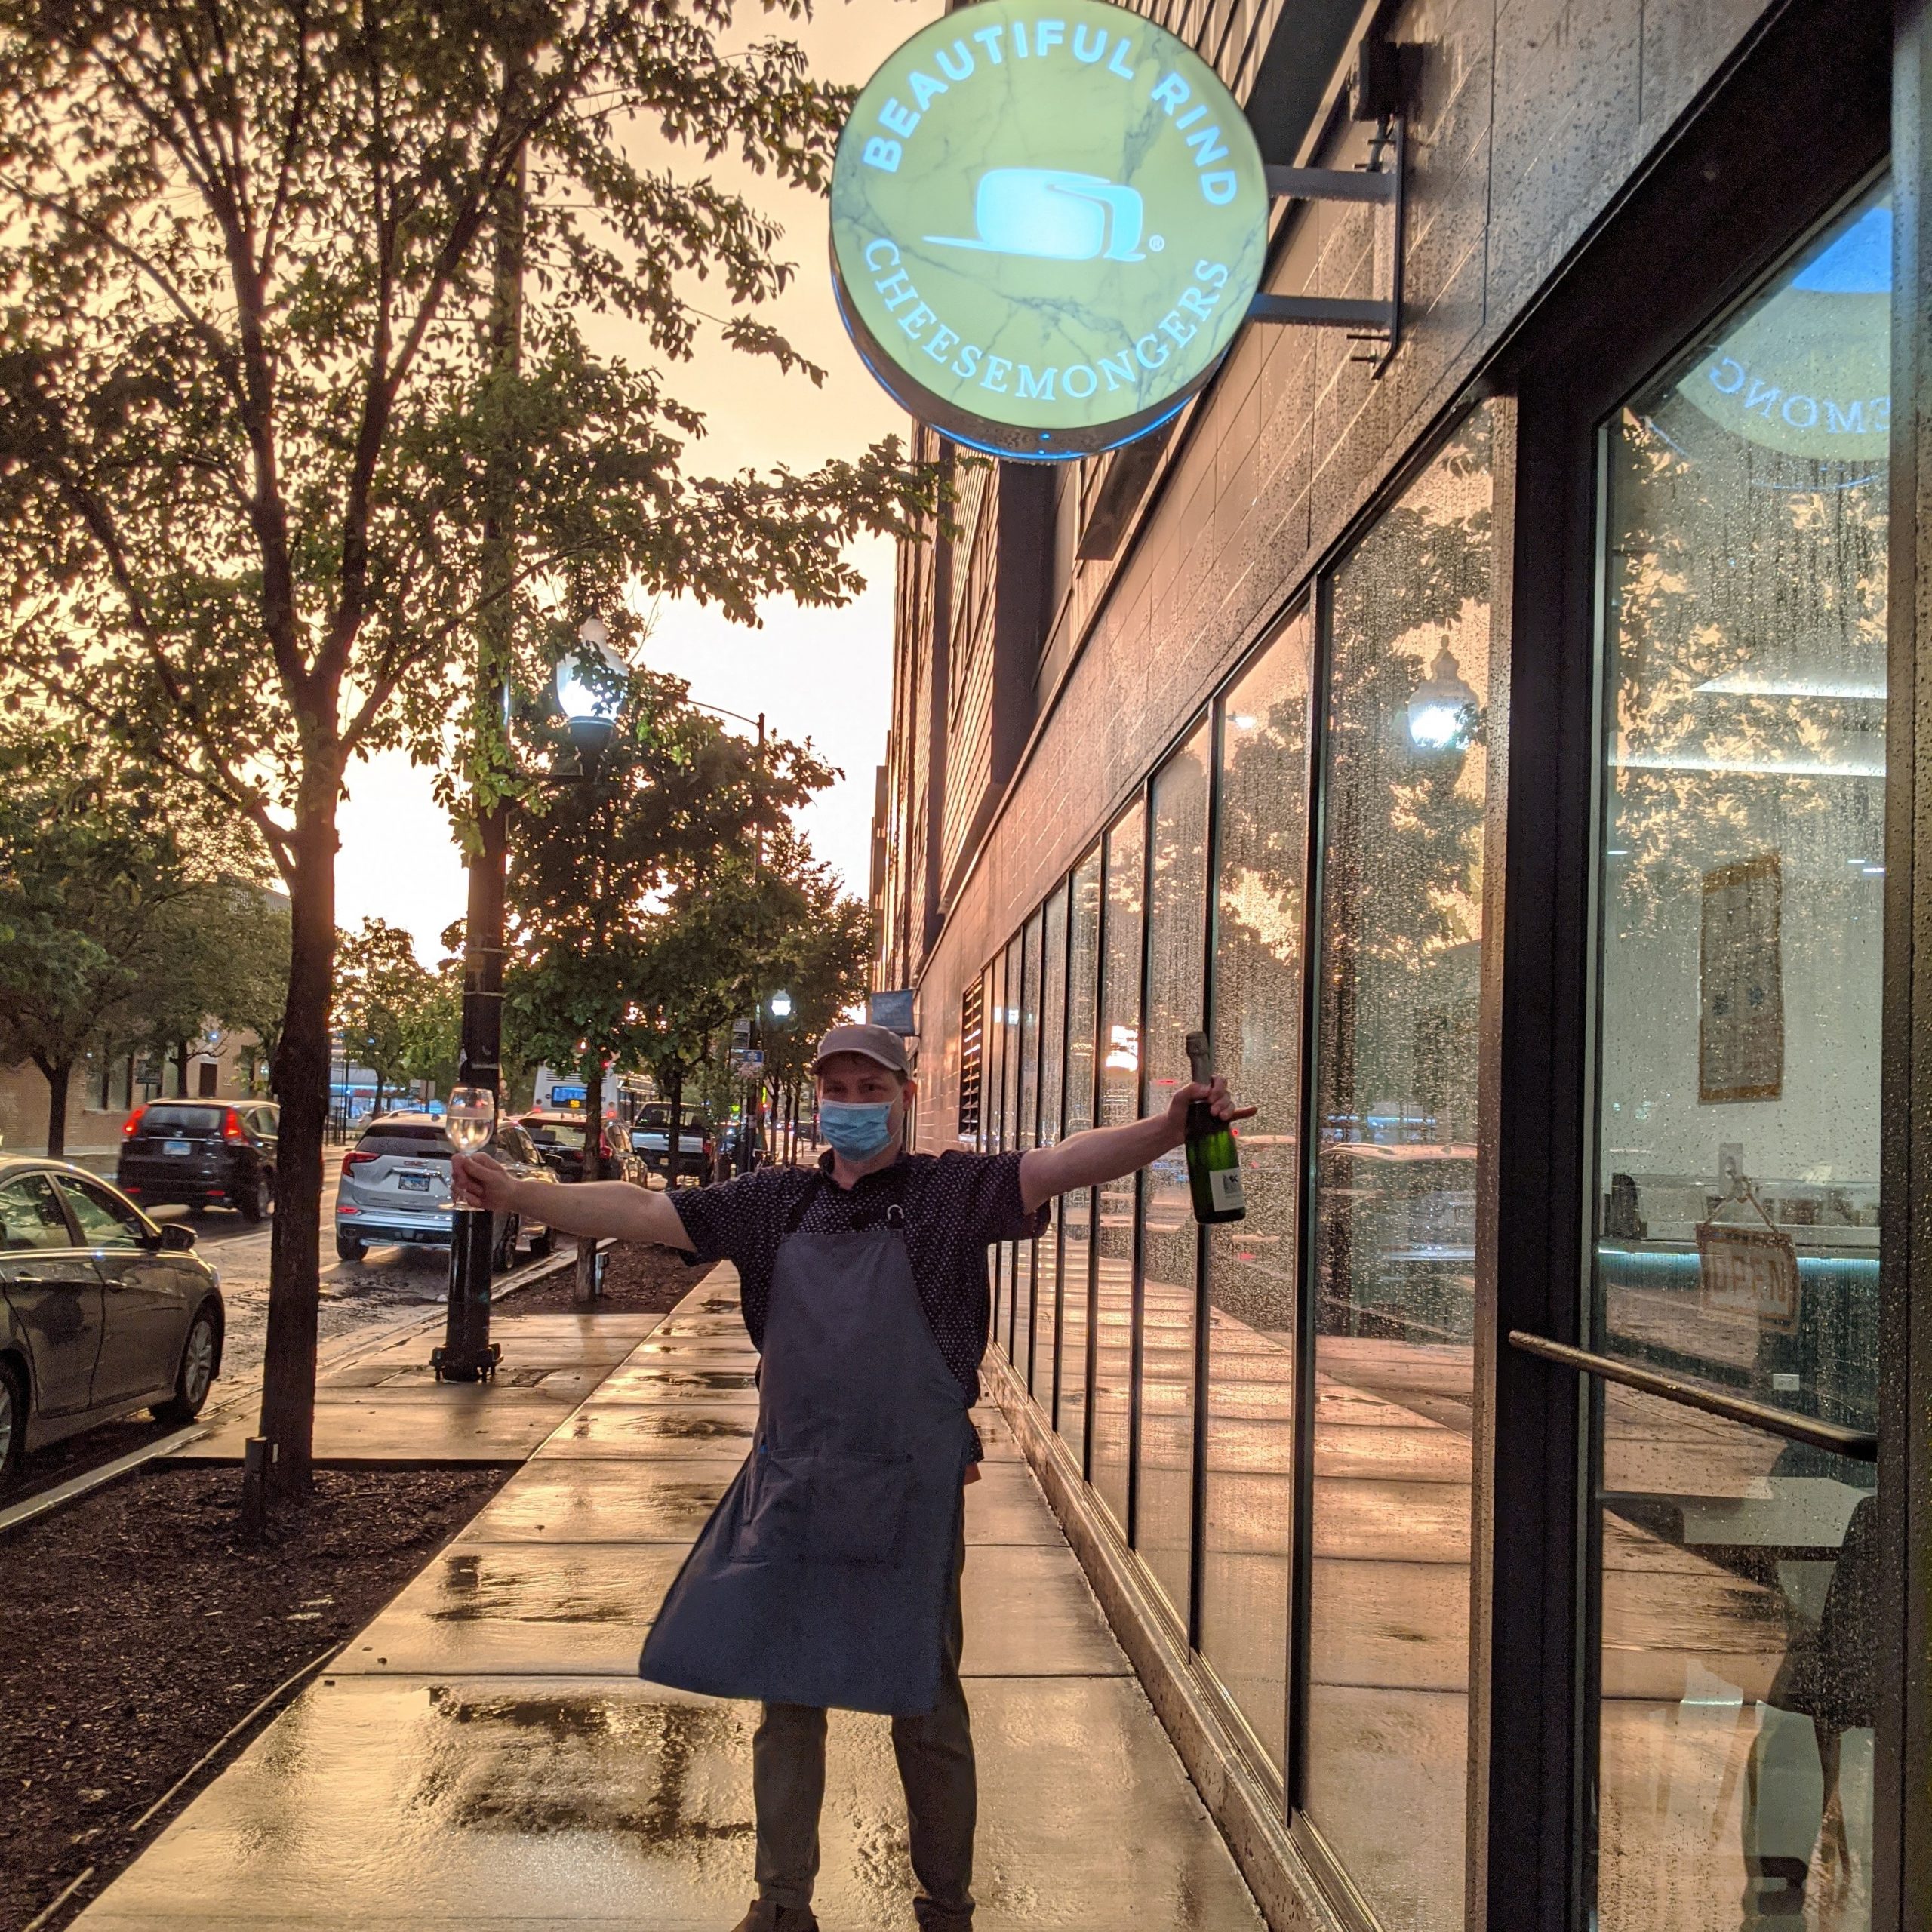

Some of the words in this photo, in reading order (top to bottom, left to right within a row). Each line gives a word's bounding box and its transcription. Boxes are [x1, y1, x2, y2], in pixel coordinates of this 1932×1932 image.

[863, 20, 1134, 173] BEAUTIFUL
[1152, 72, 1237, 205] RIND
[866, 238, 1229, 401] CHEESEMONGERS
